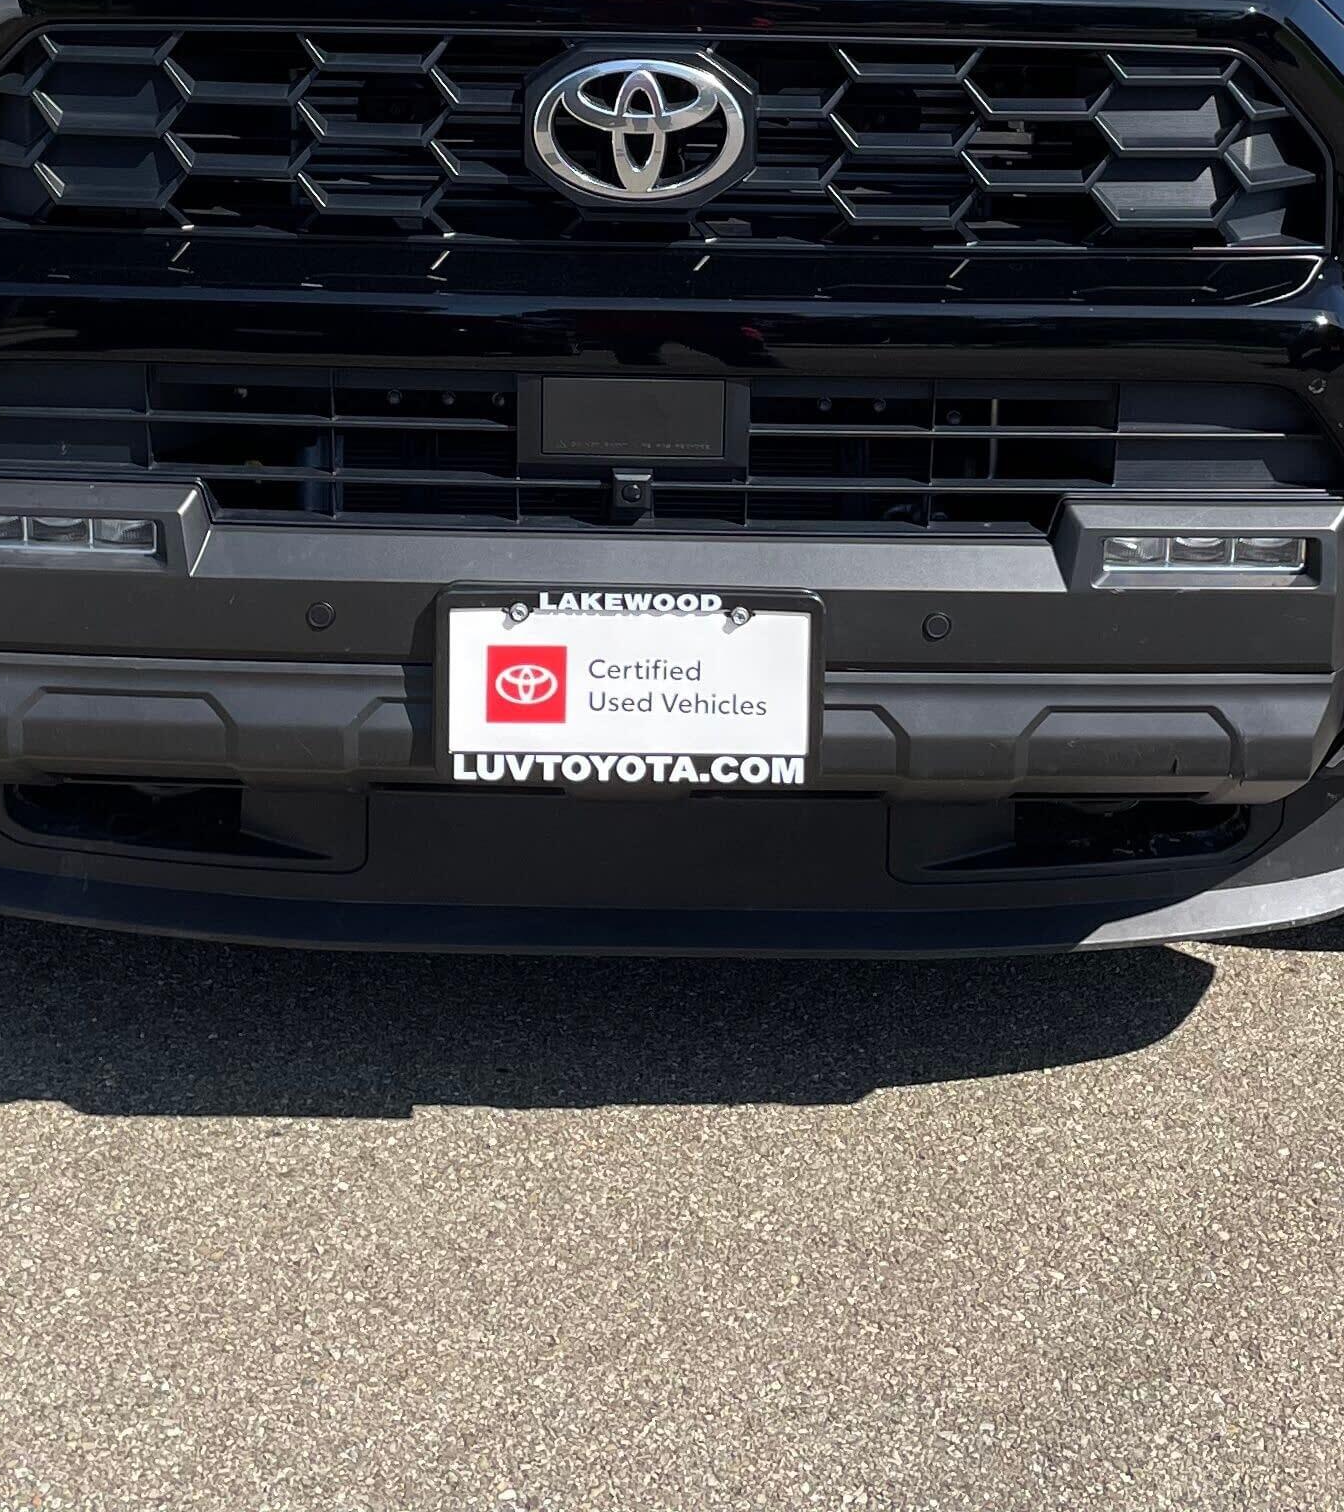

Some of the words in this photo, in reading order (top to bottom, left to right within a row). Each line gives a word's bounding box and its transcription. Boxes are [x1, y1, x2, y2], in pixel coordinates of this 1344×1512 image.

[539, 591, 722, 612] LAKEWOOD
[588, 659, 702, 682] Certified
[588, 691, 653, 713] Used
[661, 692, 767, 716] Vehicles
[453, 753, 805, 785] LUVTOYOTA.COM
